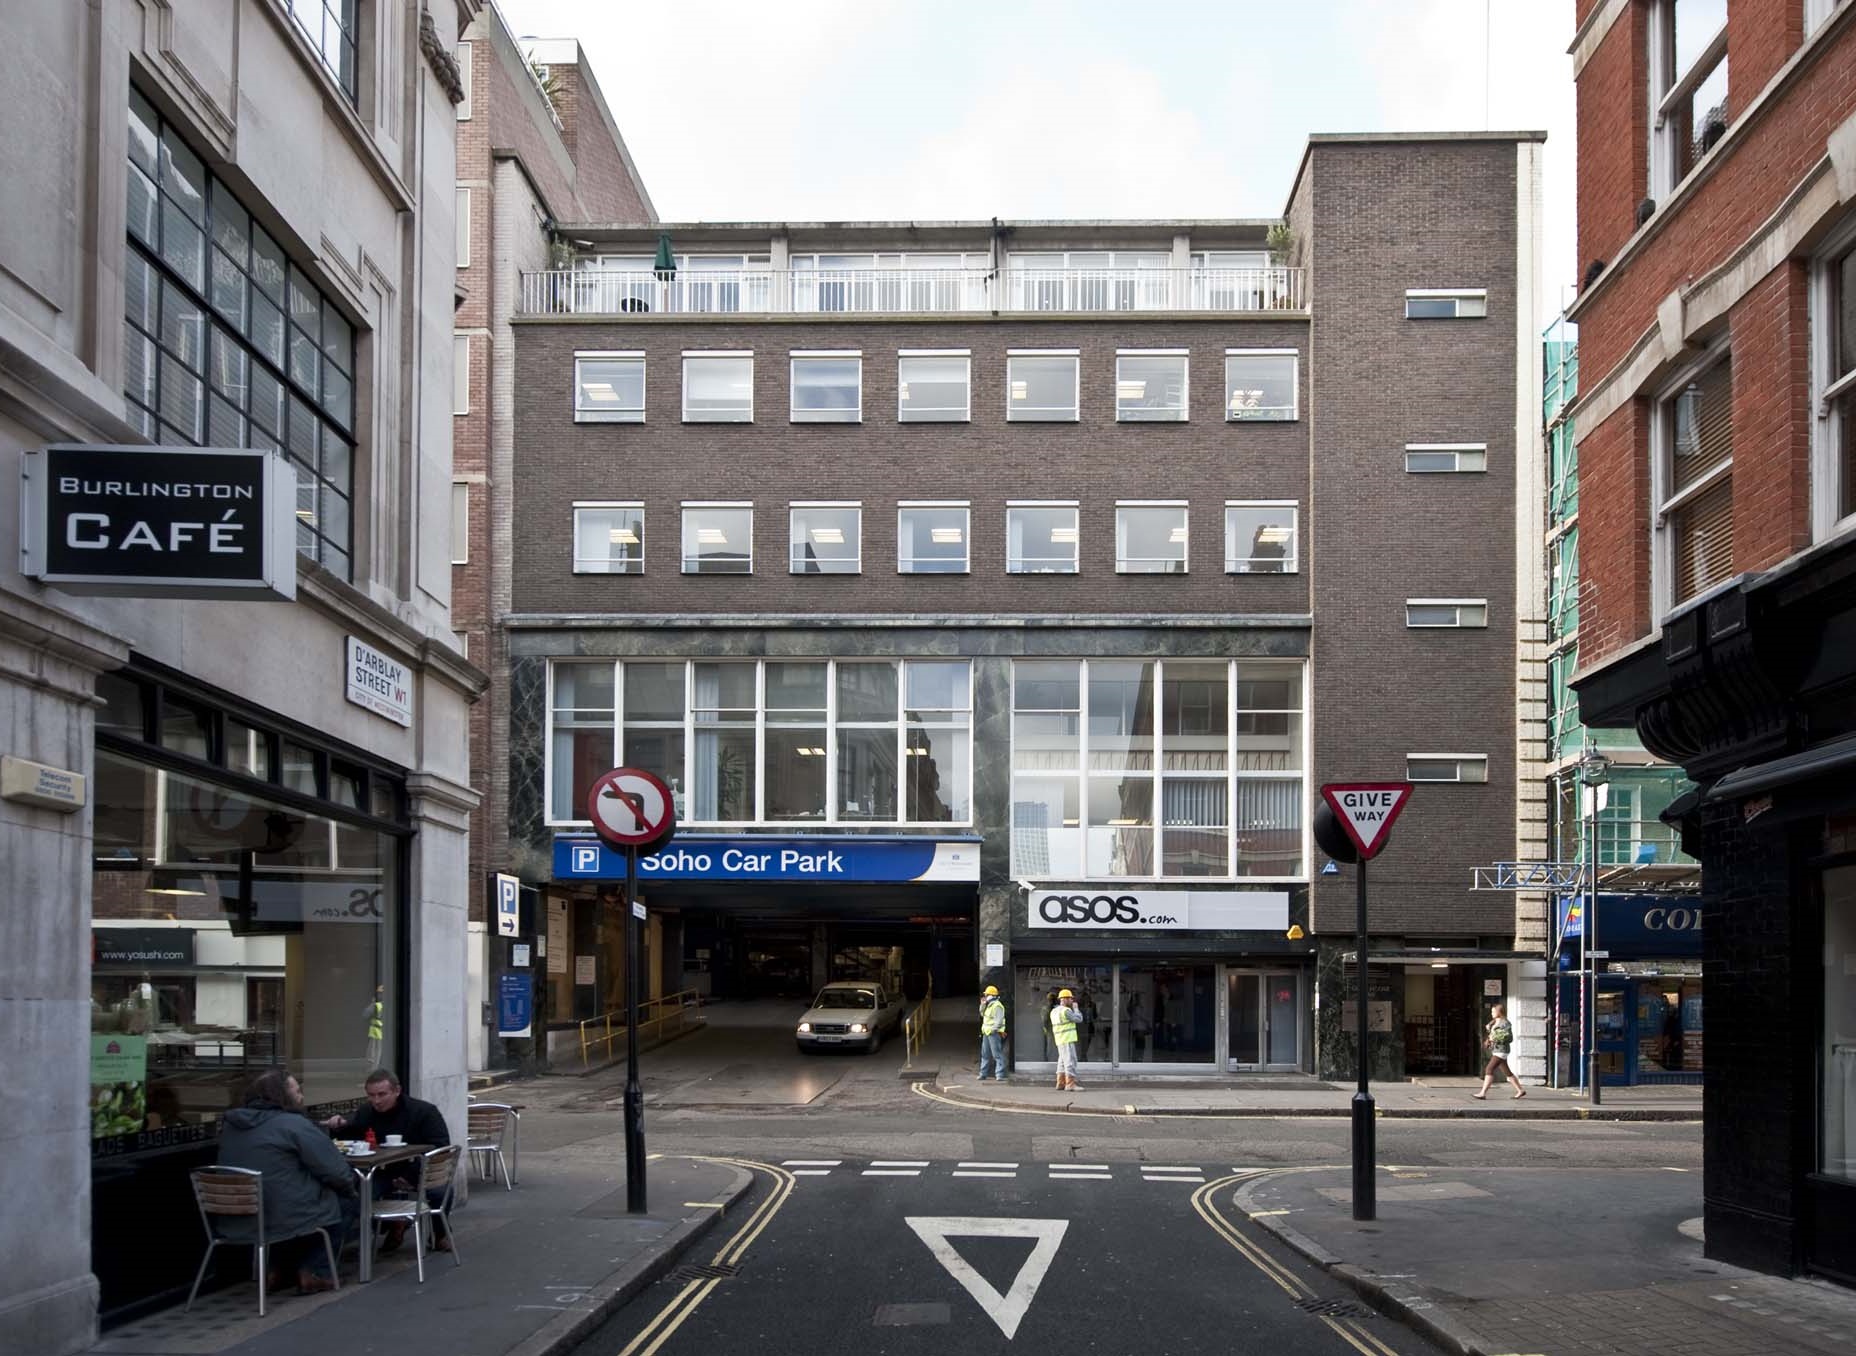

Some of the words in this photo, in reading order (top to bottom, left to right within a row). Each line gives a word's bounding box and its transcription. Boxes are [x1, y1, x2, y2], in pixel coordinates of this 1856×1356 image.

[59, 477, 253, 499] BURLINGTON
[66, 509, 244, 553] CAFÉ
[356, 646, 402, 683] D'ARBLAY
[355, 666, 391, 697] STREET
[394, 686, 407, 706] W1
[1343, 793, 1391, 807] GIVE
[1354, 811, 1384, 821] WAY
[578, 850, 595, 870] P
[641, 849, 711, 872] Soho
[722, 849, 771, 872] Car
[780, 850, 844, 872] Park
[503, 882, 515, 911] P
[101, 950, 185, 961] www.yosushi.com
[137, 1124, 207, 1148] BAGUETTES
